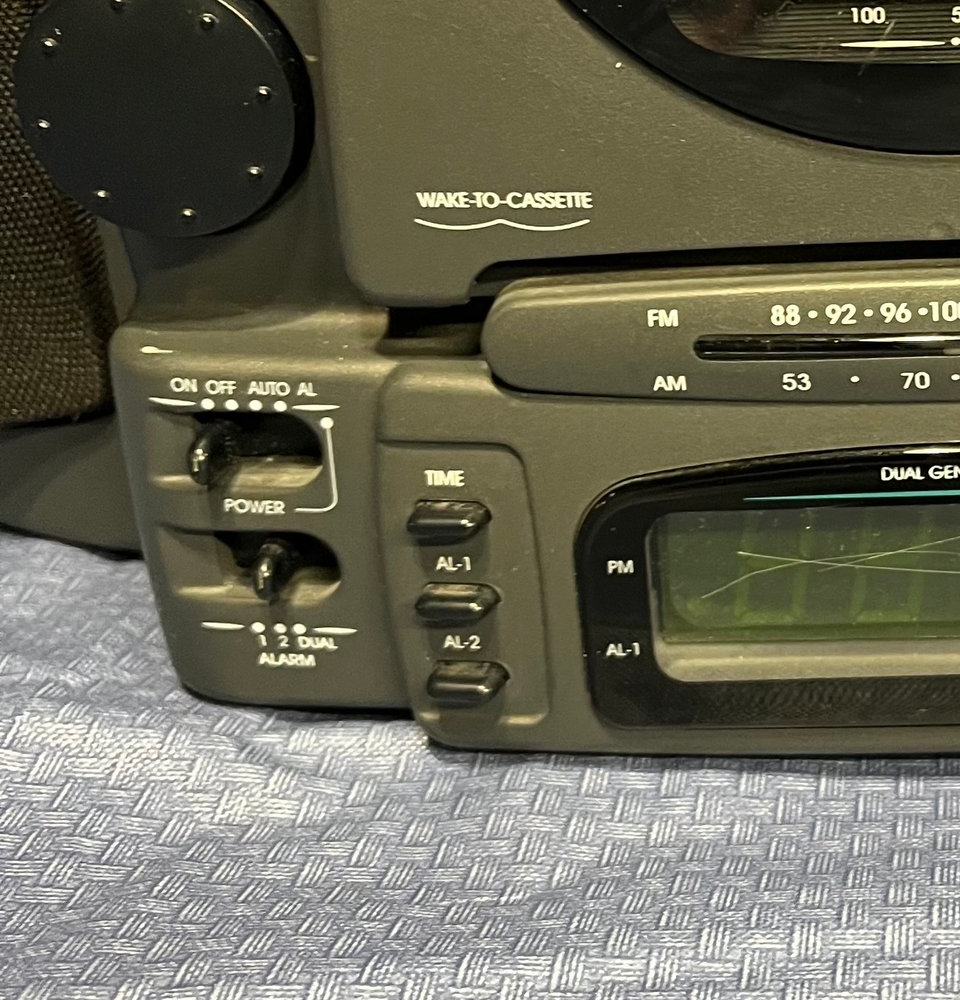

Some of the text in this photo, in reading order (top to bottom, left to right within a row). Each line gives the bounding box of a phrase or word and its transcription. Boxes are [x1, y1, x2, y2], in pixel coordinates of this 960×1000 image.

[851, 7, 885, 23] 100
[416, 192, 593, 208] WAKE-TO-CASSETTE
[648, 309, 678, 327] FM
[771, 305, 800, 325] 88
[825, 304, 856, 324] 92
[880, 303, 911, 323] 96
[170, 378, 317, 396] ON OFF AUTO AL
[654, 376, 686, 391] AM
[783, 373, 811, 390] 53
[901, 372, 930, 389] 70
[425, 470, 464, 486] TIME
[881, 467, 925, 480] DUAL
[225, 499, 285, 514] POWER
[436, 557, 470, 570] AL-1
[608, 560, 633, 573] PM
[258, 635, 338, 651] 1 2 DUAL
[444, 636, 480, 649] AL-2
[606, 643, 639, 656] AL-1
[259, 652, 316, 667] ALARM
